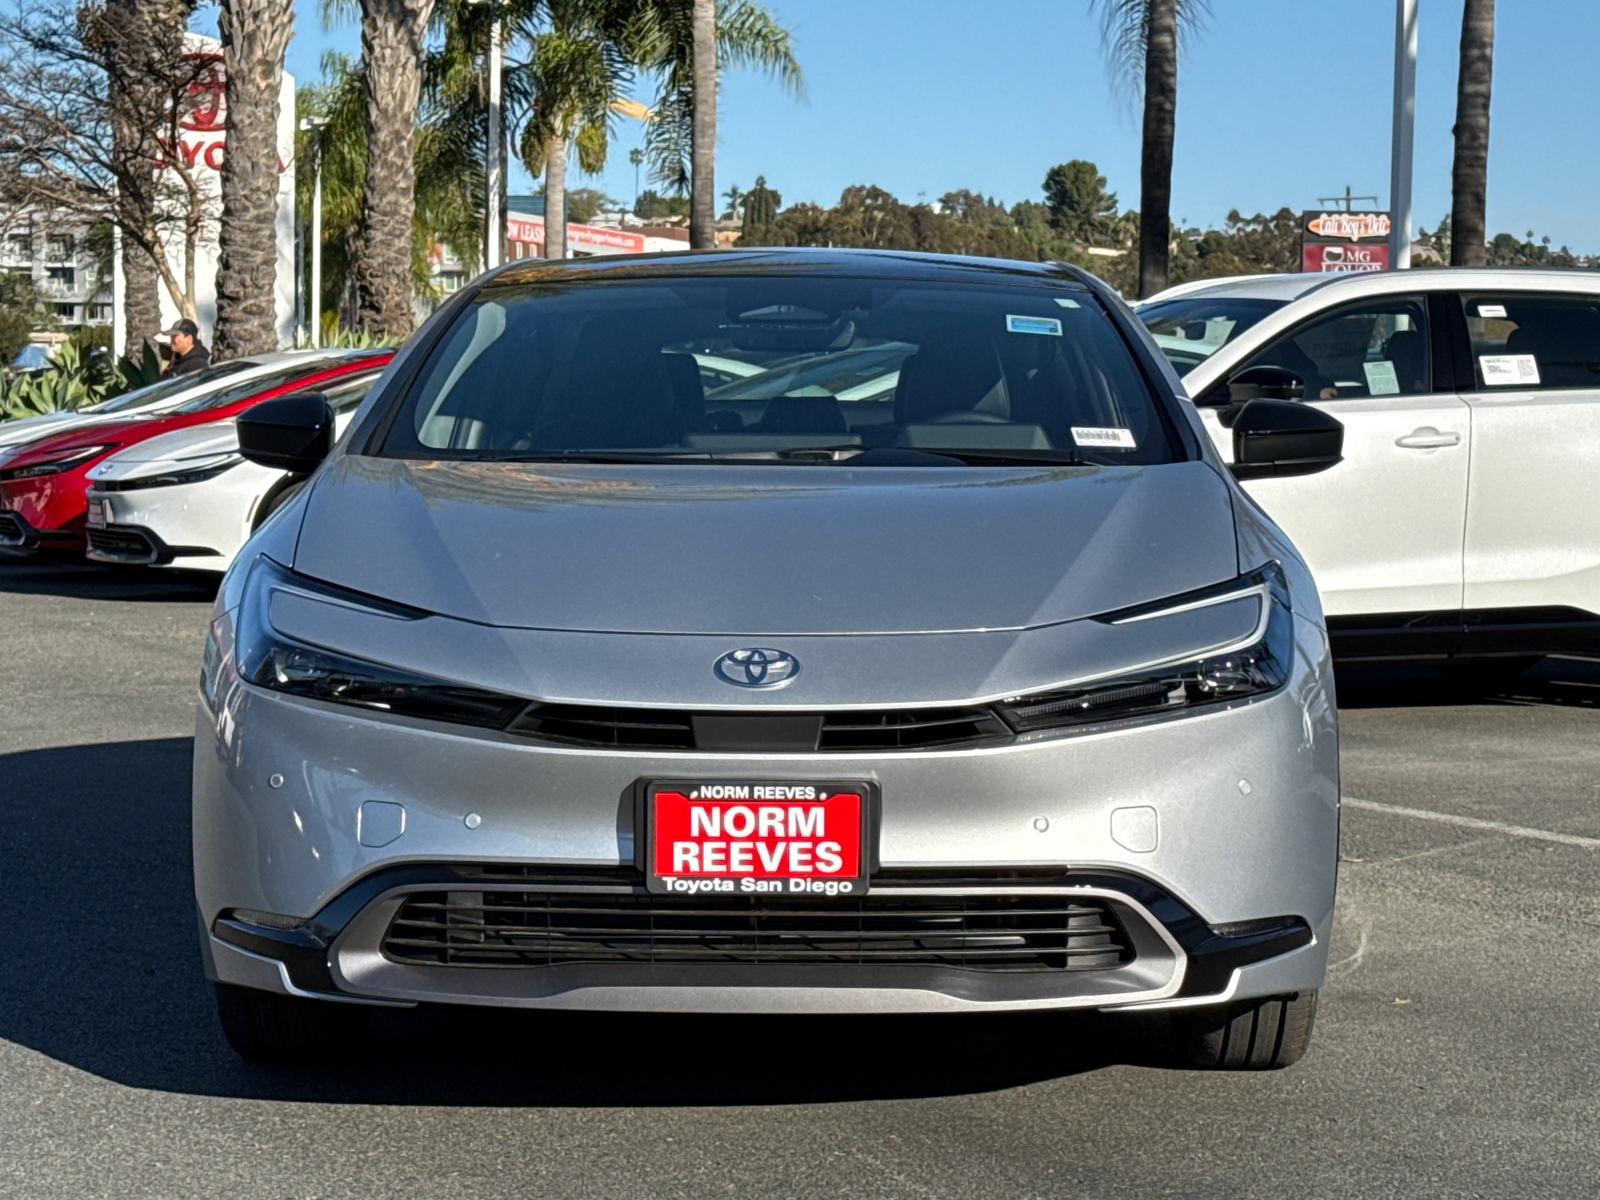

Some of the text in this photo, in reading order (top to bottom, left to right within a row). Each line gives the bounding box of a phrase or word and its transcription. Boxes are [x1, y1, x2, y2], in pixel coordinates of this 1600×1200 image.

[1320, 214, 1338, 235] Cali
[1367, 214, 1387, 235] Deli
[1346, 250, 1371, 262] MG
[700, 785, 815, 800] NORM REEVES
[690, 806, 825, 838] NORM
[673, 841, 843, 873] REEVES
[662, 876, 853, 895] Toyota San Diego
